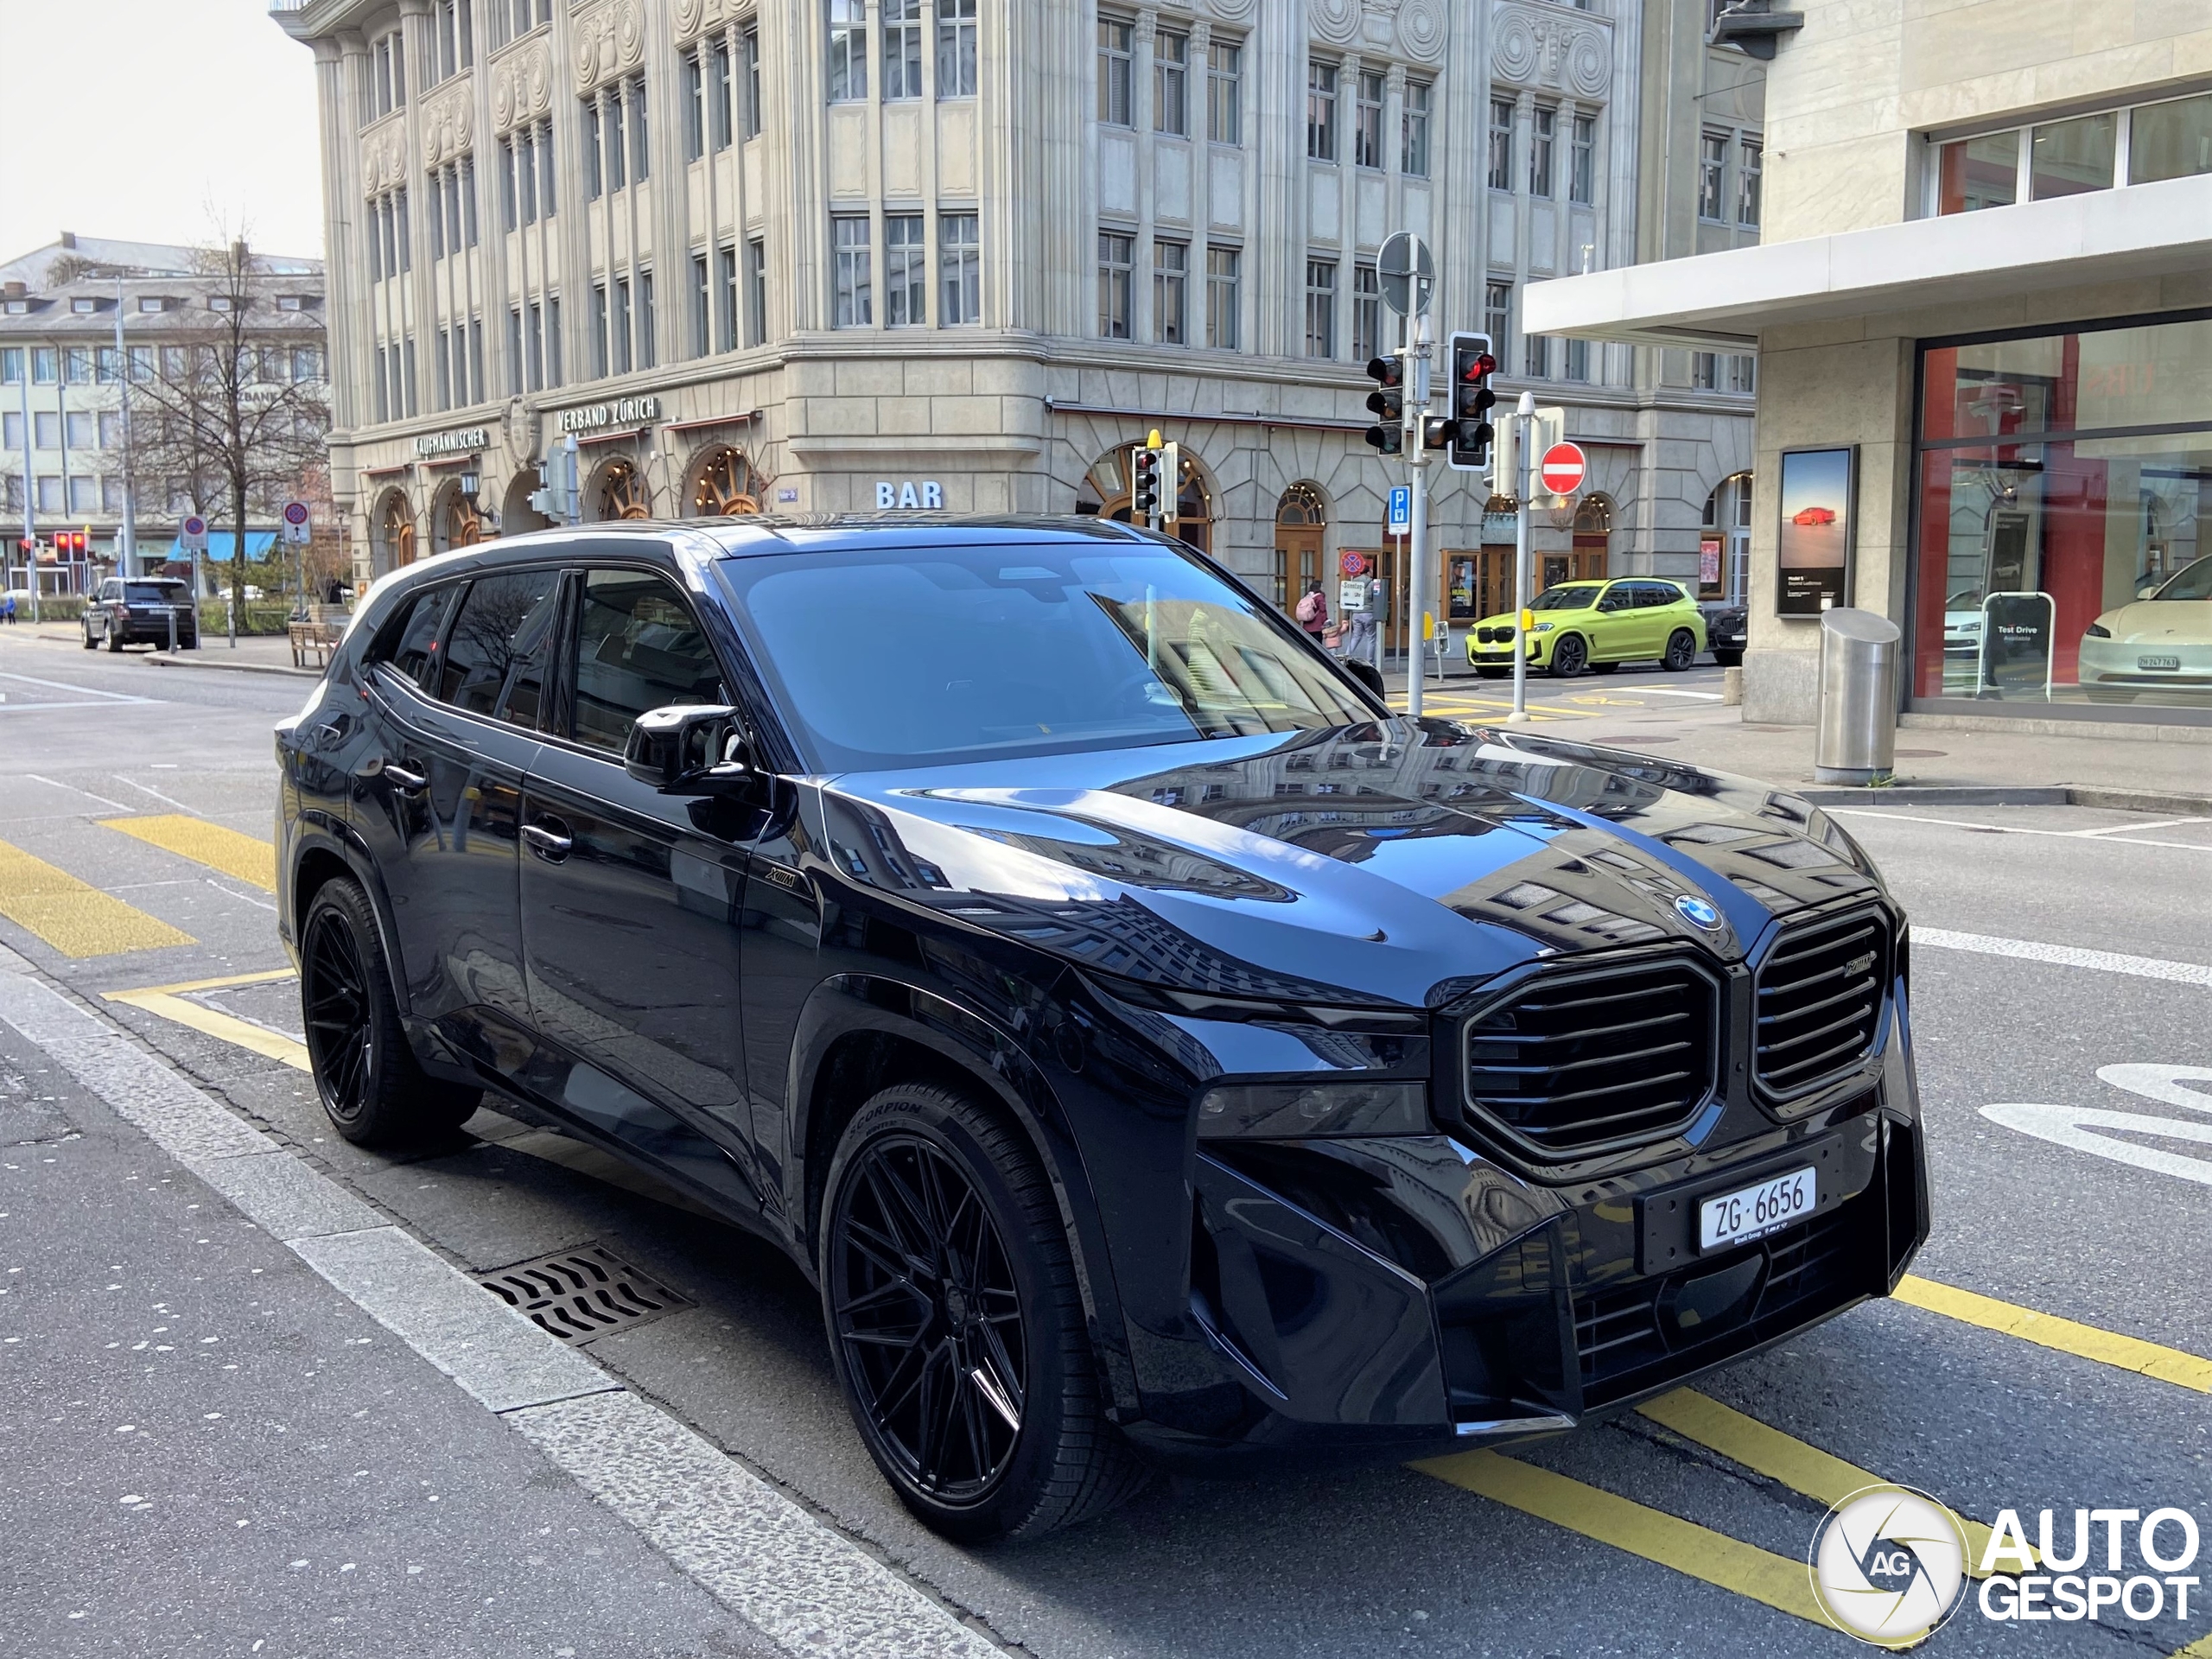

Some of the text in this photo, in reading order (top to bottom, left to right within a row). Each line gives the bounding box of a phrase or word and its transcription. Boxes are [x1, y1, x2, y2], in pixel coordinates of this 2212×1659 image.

[557, 397, 654, 430] VERBAND ZÜRICH
[875, 481, 942, 509] BAR
[1395, 491, 1404, 508] P
[2016, 626, 2037, 634] Drive
[849, 1102, 922, 1140] SCORPION
